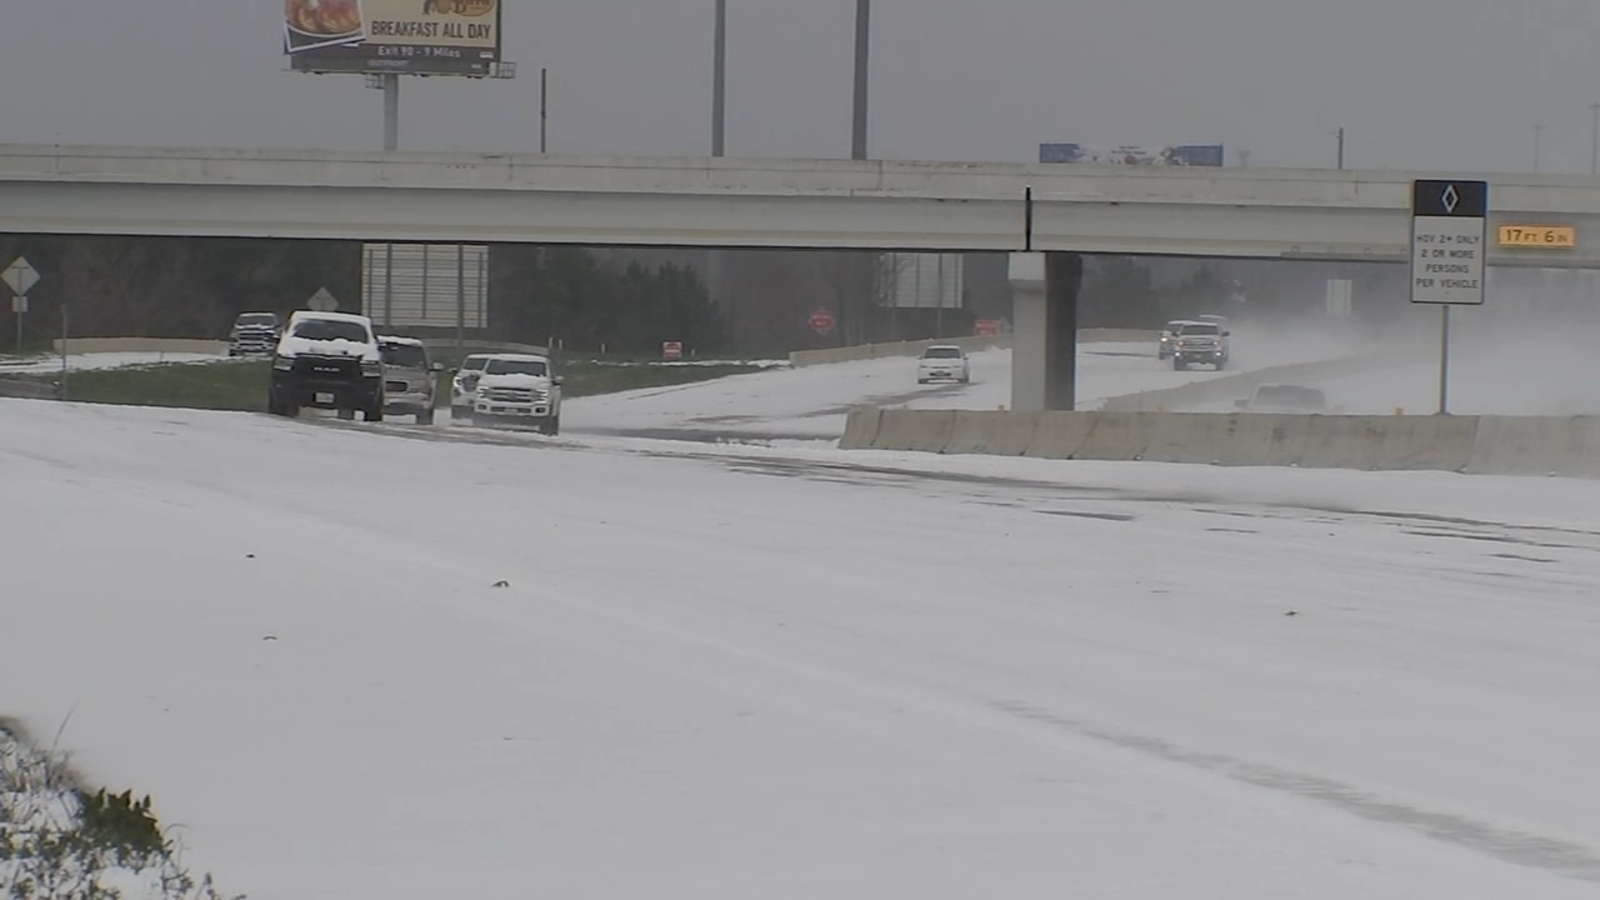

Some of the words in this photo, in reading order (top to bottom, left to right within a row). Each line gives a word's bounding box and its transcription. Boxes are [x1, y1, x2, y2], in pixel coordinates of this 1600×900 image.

[371, 20, 438, 38] BREAKFAST
[443, 22, 465, 38] ALL
[468, 23, 491, 39] DAY
[378, 46, 399, 56] Exit
[401, 46, 413, 57] 90
[424, 47, 431, 57] 9
[433, 47, 460, 58] Miles
[1416, 234, 1435, 244] HOV
[1439, 234, 1453, 244] 2+
[1457, 235, 1480, 245] ONLY
[1506, 229, 1522, 241] 17
[1524, 234, 1537, 242] FT
[1544, 231, 1555, 243] 6
[1557, 234, 1568, 242] IN
[1421, 249, 1427, 258] 2
[1433, 249, 1445, 259] OR
[1449, 250, 1475, 259] MORE
[1425, 264, 1469, 274] PERSONS
[1416, 278, 1435, 288] PER
[1440, 279, 1478, 289] VEHICLE
